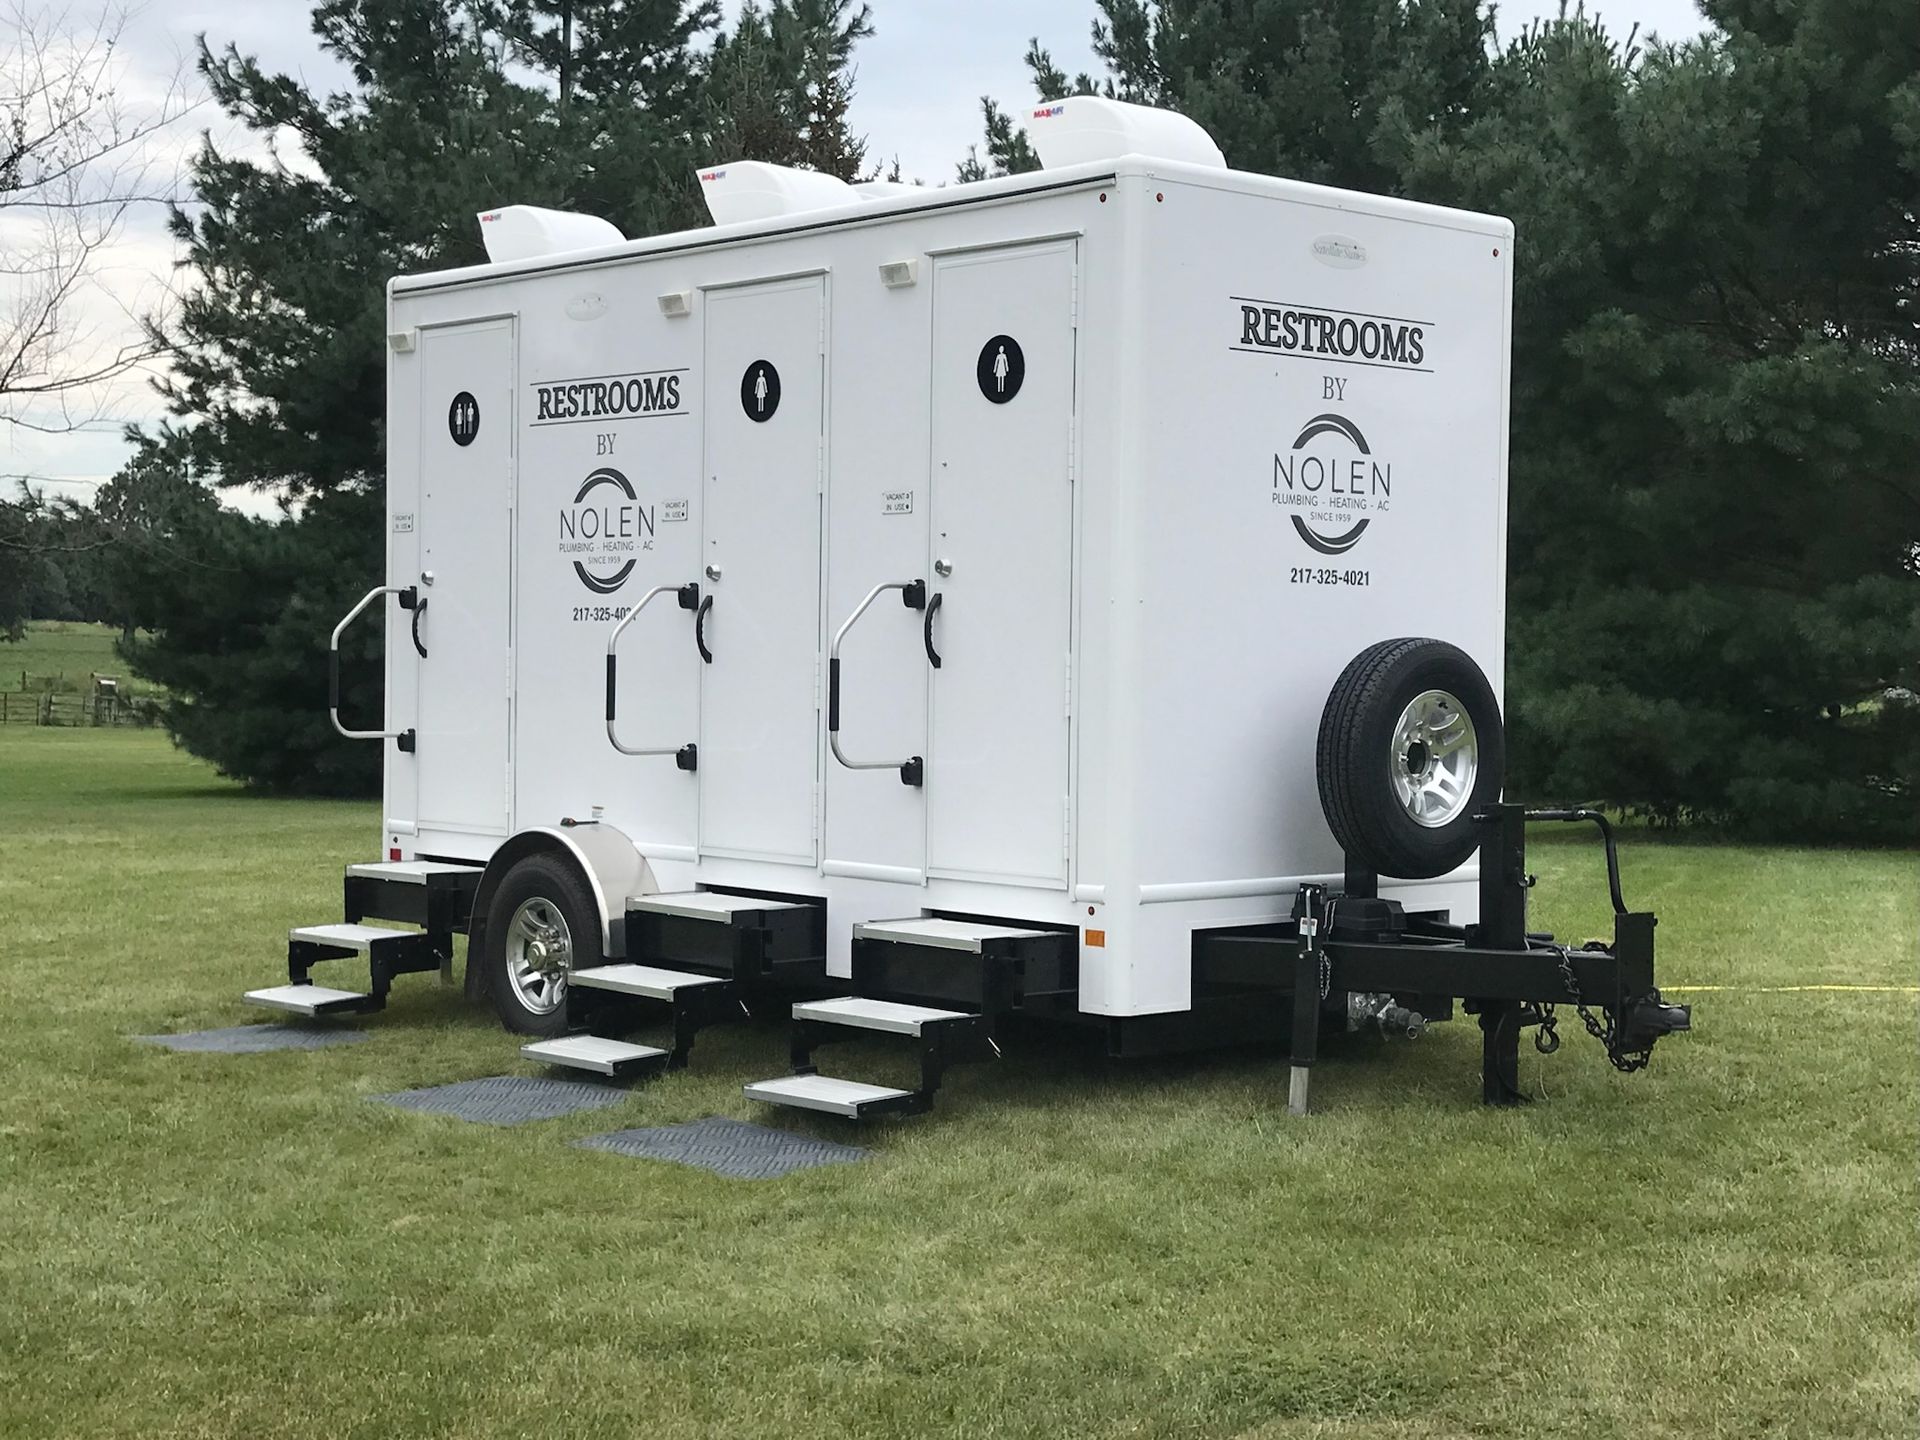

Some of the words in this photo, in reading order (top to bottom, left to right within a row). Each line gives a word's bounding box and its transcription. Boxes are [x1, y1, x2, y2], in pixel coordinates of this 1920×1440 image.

[1240, 305, 1424, 364] RESTROOMS
[537, 375, 680, 420] RESTROOMS
[1322, 376, 1348, 401] BY
[596, 433, 617, 455] BY
[1273, 453, 1391, 497] NOLEN
[1272, 492, 1319, 507] PLUMBING
[1329, 497, 1367, 510] HEATING
[1376, 500, 1390, 512] AC
[560, 505, 654, 539] NOLEN
[1310, 511, 1333, 522] SINCE
[1335, 513, 1352, 523] 1959
[559, 542, 594, 553] PLUMBING
[602, 541, 634, 552] HEATING
[642, 540, 654, 551] AC
[587, 556, 606, 565] SINCE
[607, 555, 621, 564] 1959
[1290, 567, 1370, 586] 217-325-4021
[573, 607, 637, 621] 217-325-40
